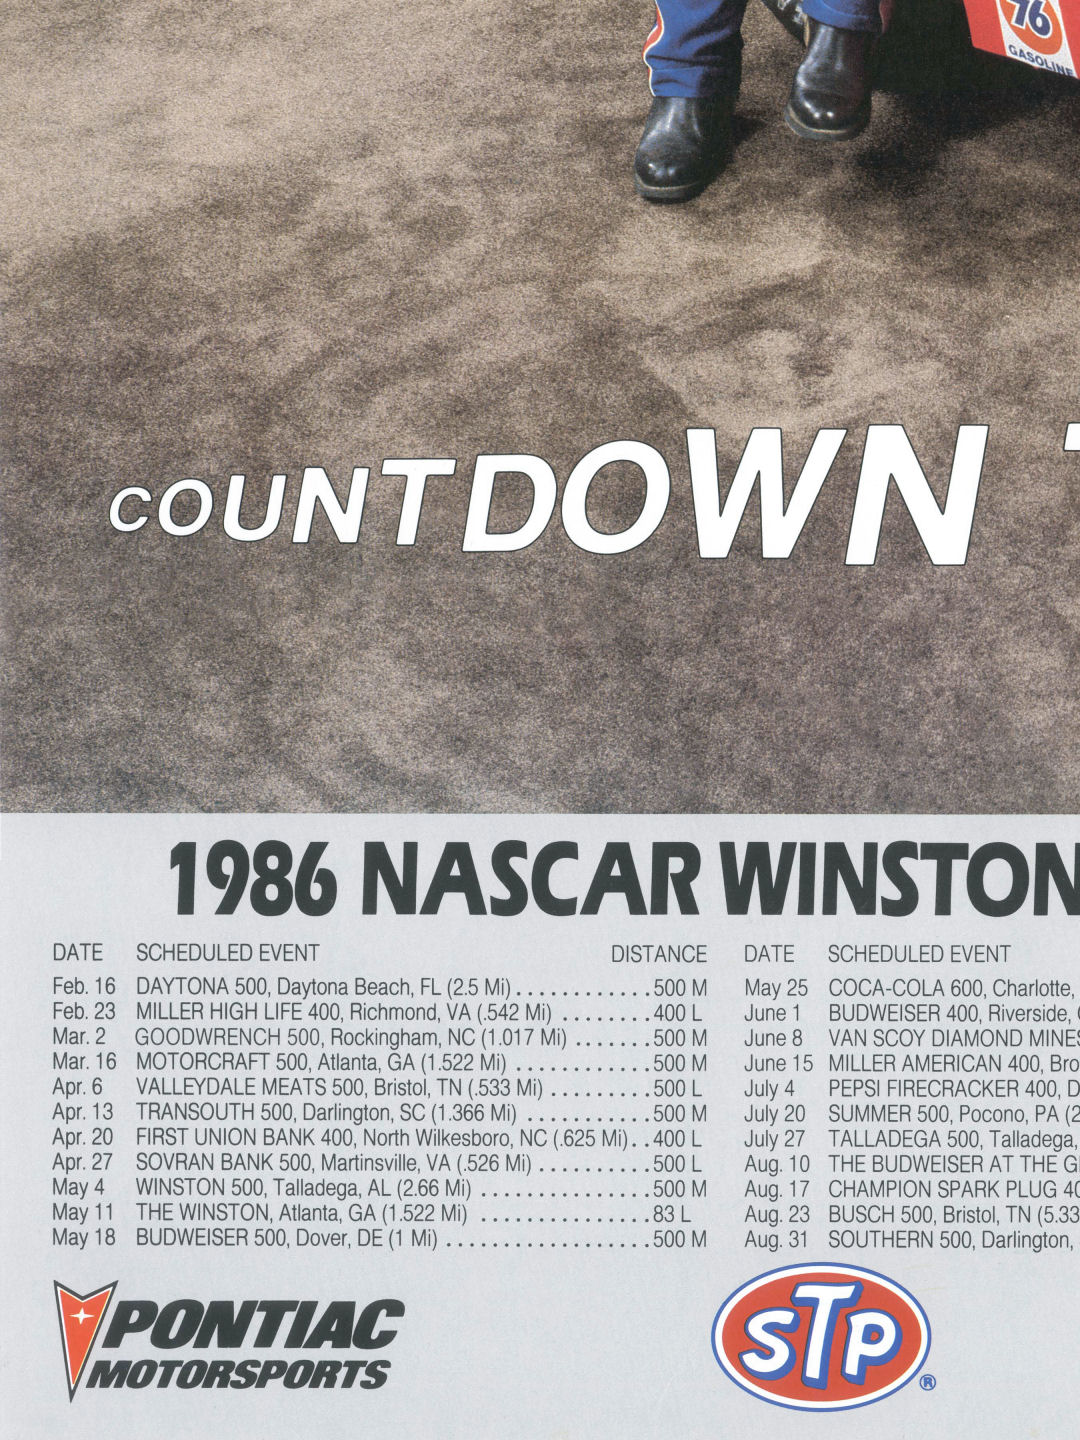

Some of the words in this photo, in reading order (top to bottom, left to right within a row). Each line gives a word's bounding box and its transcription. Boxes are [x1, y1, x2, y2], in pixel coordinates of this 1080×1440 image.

[1008, 44, 1075, 78] GASOLINE
[109, 421, 984, 565] COUNTDOWN
[170, 840, 337, 916] 1986
[362, 840, 701, 916] NASCAR
[53, 943, 103, 961] DATE
[136, 943, 253, 962] SCHEDULED
[260, 944, 320, 962] EVENT
[612, 944, 707, 963] DISTANCE
[745, 944, 794, 962] DATE
[828, 944, 944, 963] SCHEDULED
[951, 944, 1011, 963] EVENT
[53, 976, 88, 994] Feb.
[96, 976, 116, 995] 16
[137, 976, 229, 995] DAYTONA
[235, 977, 271, 998] 500,
[278, 977, 348, 1000] Daytona
[355, 977, 414, 998] Beach,
[421, 978, 442, 996] FL
[447, 978, 478, 1000] (2.5
[485, 978, 510, 1000] Mi)
[654, 978, 686, 997] 500
[692, 978, 707, 996] M
[746, 978, 781, 1000] May
[787, 978, 808, 996] 25
[829, 978, 945, 997] COCA-COLA
[951, 979, 986, 999] 600,
[993, 978, 1074, 999] Charlotte,
[53, 1052, 89, 1070] Mar.
[96, 1052, 116, 1070] 16
[137, 1052, 270, 1070] MOTORCRAFT
[276, 1052, 312, 1073] 500,
[318, 1053, 381, 1074] Atlanta,
[388, 1052, 415, 1071] GA
[421, 1053, 474, 1074] (1.522
[480, 1053, 506, 1074] Mi)
[654, 1054, 686, 1072] 500
[692, 1054, 707, 1072] M
[744, 1154, 782, 1177] Aug.
[790, 1154, 810, 1172] 10
[828, 1154, 866, 1172] THE
[872, 1154, 983, 1173] BUDWEISER
[989, 1155, 1014, 1172] AT
[1020, 1155, 1057, 1173] THE
[104, 1298, 406, 1351] PONTIAC
[739, 1282, 904, 1389] STP
[87, 1358, 392, 1391] MOTORSPORTS
